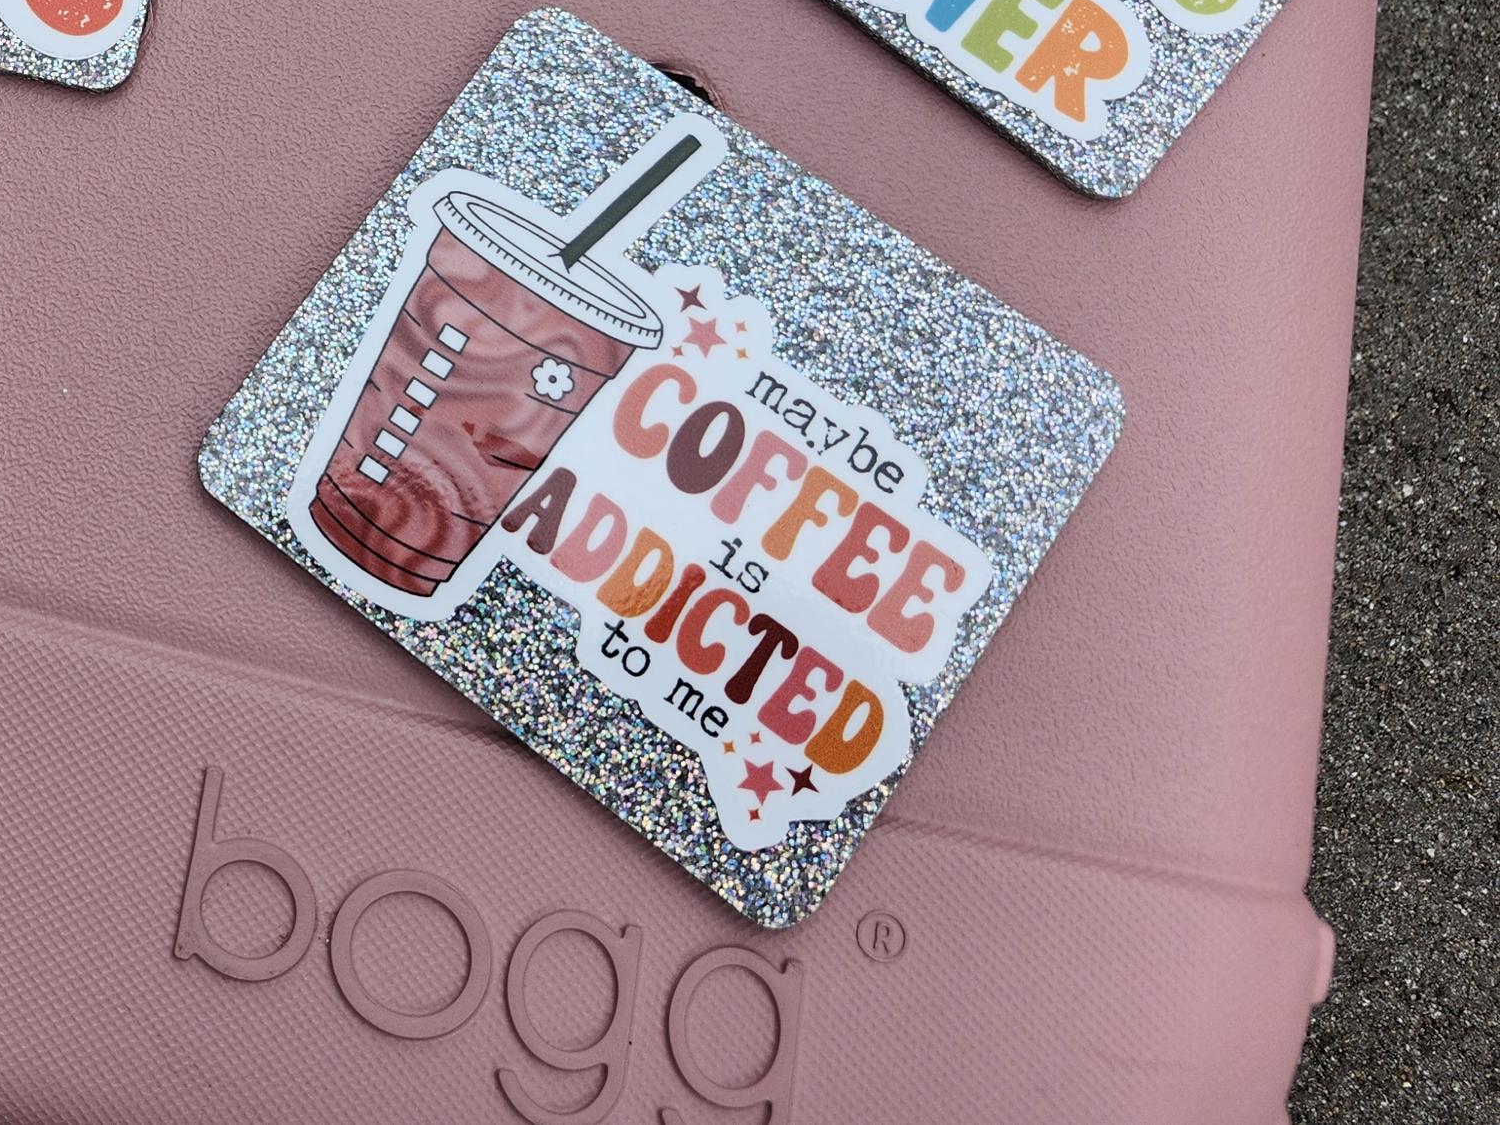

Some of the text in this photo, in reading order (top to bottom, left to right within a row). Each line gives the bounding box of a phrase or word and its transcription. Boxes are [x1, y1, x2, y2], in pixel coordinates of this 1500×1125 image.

[613, 363, 966, 654] COFFEE
[745, 371, 905, 494] maybe
[500, 466, 884, 774] ADDICTED
[708, 537, 770, 594] is
[600, 619, 729, 738] to me
[173, 765, 804, 1125] bogg
